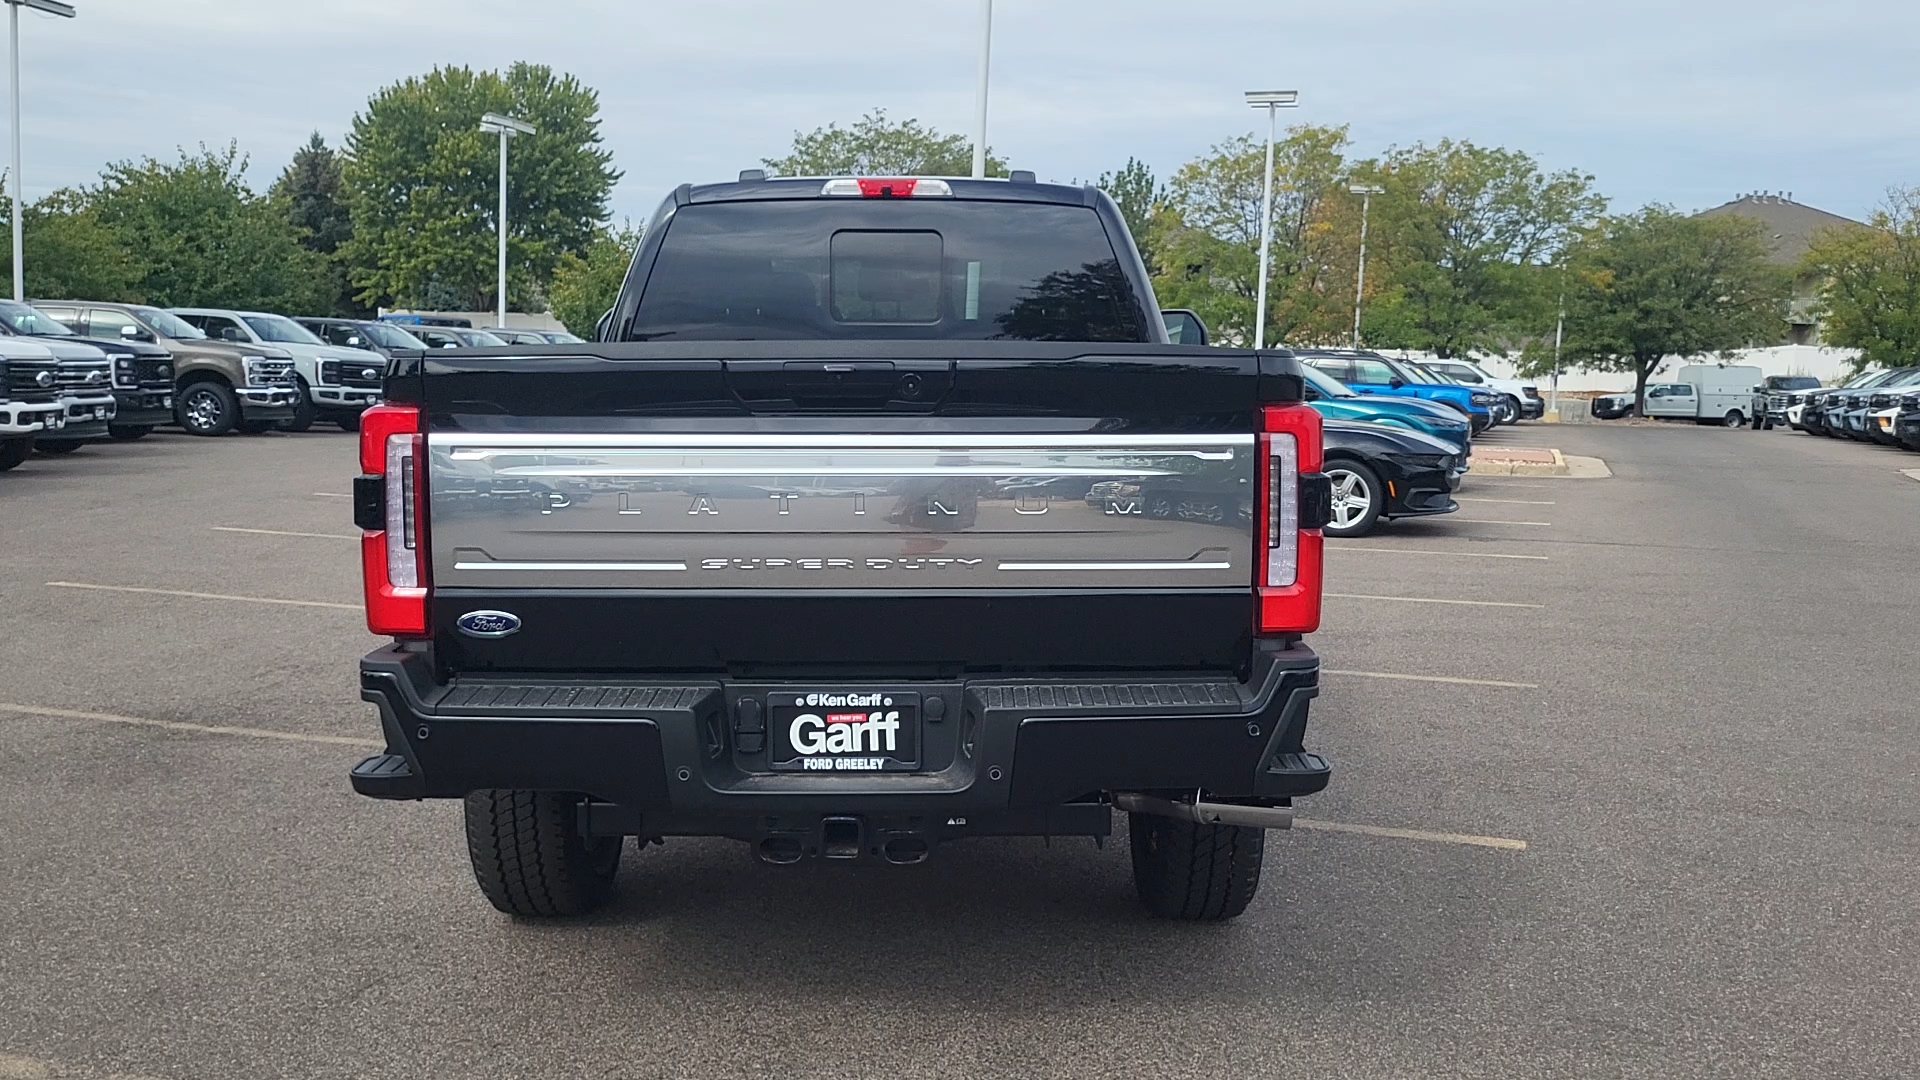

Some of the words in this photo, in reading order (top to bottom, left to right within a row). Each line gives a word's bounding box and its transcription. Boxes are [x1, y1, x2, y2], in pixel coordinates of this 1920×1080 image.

[541, 493, 1142, 515] PLATINUM
[701, 558, 853, 570] SUPER
[866, 558, 983, 570] DUTY
[471, 615, 506, 631] Ford
[818, 693, 846, 707] Ken
[847, 693, 882, 707] Garff
[789, 711, 900, 755] Garff
[803, 758, 833, 770] FORD
[835, 758, 885, 770] GREELEY
